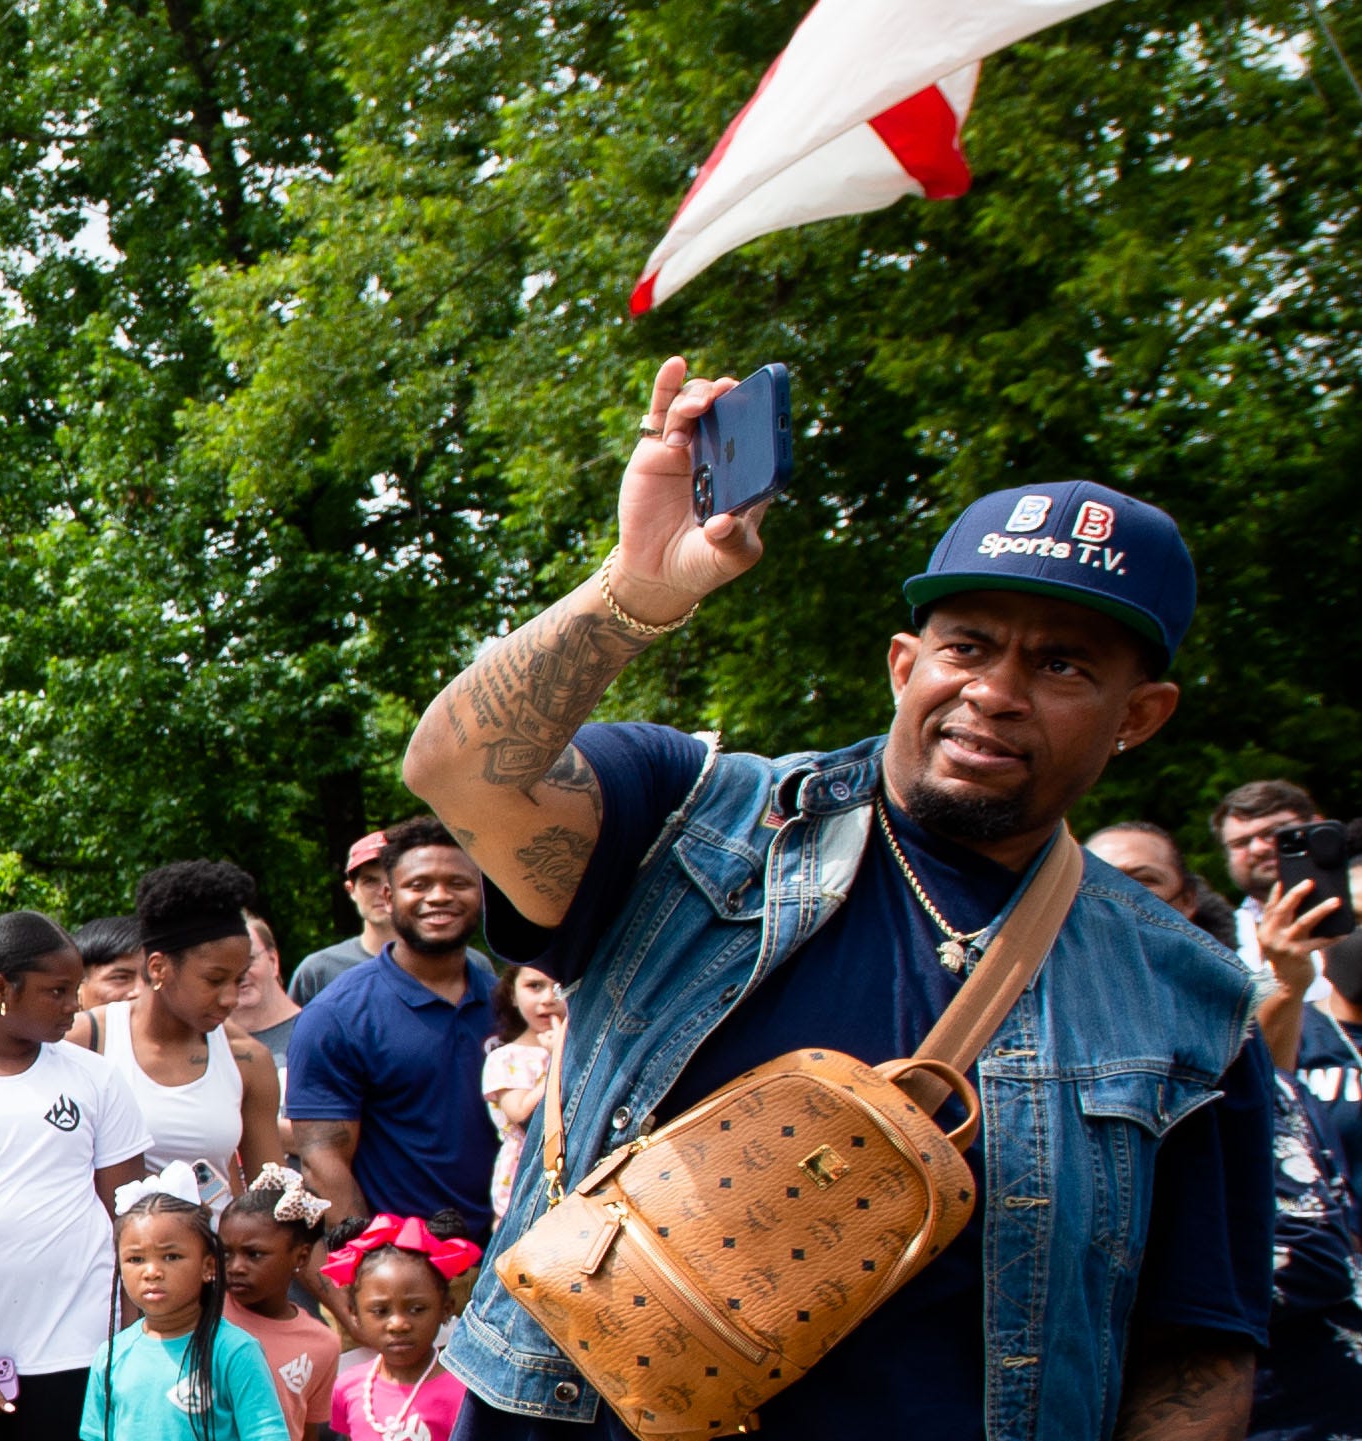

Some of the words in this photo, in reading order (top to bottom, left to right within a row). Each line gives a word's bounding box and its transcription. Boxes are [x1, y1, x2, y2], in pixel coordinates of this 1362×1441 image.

[1005, 494, 1053, 533] B
[1071, 500, 1116, 543] B
[977, 532, 1072, 559] Sports
[1077, 542, 1127, 576] T.V.
